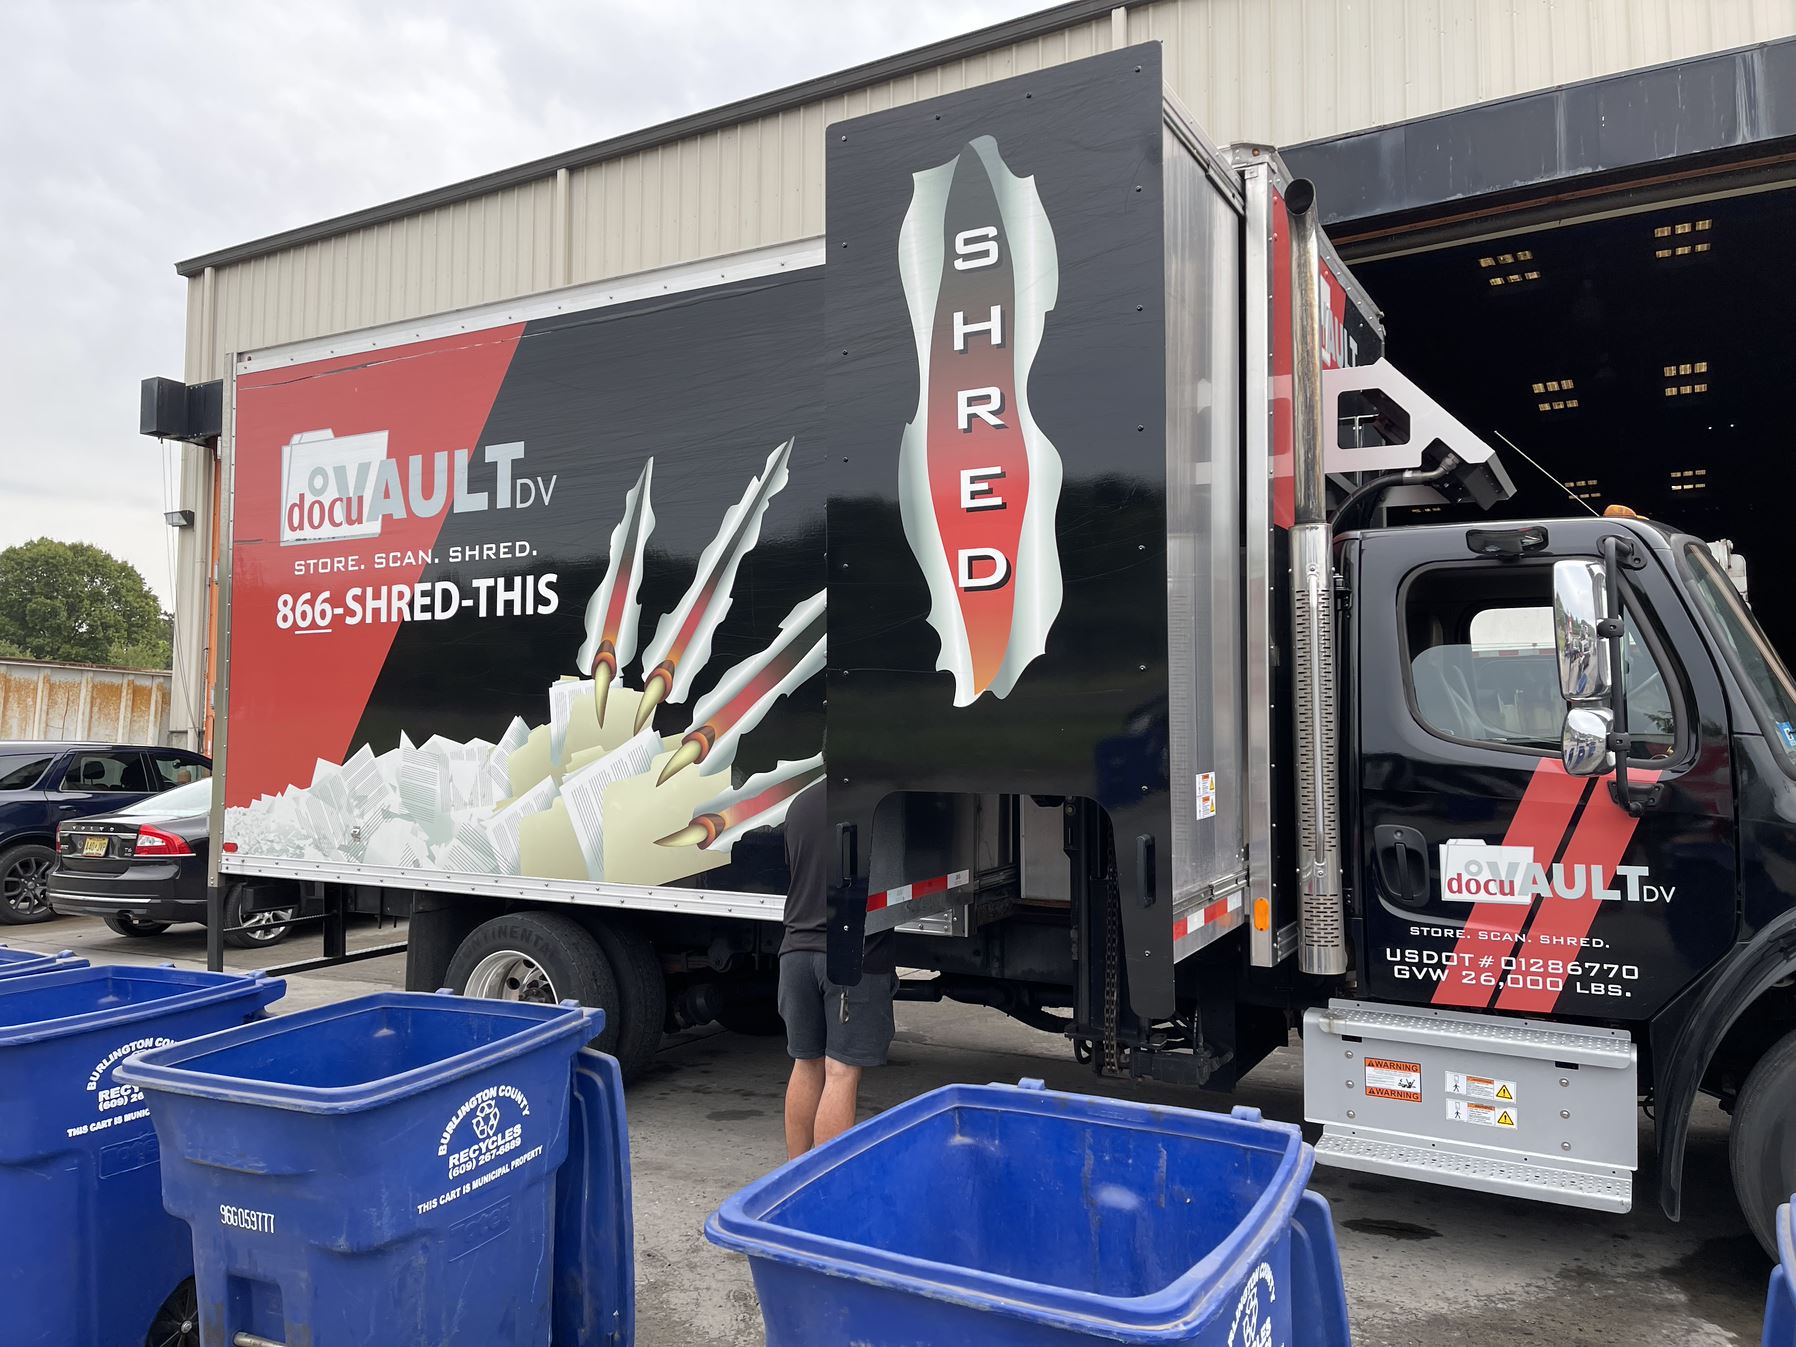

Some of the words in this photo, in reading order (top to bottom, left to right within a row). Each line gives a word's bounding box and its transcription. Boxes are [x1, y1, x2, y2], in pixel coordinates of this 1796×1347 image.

[953, 225, 1010, 590] SHRED
[294, 555, 366, 576] STORE.
[373, 548, 440, 569] SCAN.
[448, 540, 538, 563] SHRED.
[276, 573, 560, 631] 866-SHRED-THIS
[1409, 926, 1471, 939] STORE.
[1477, 930, 1532, 943] SCAN.
[1539, 934, 1611, 949] SHRED.
[1385, 947, 1475, 967] USDOT
[1478, 955, 1495, 968] #
[1500, 956, 1640, 980] 01286770
[1393, 965, 1450, 982] GVW
[1461, 970, 1563, 990] 26,000
[1575, 981, 1632, 997] LBS.
[86, 1037, 154, 1091] BURLINGTON
[1374, 1060, 1418, 1072] WARNING
[1375, 1088, 1419, 1100] WARNING
[66, 1124, 89, 1138] THIS
[89, 1118, 113, 1132] CART
[113, 1115, 123, 1126] IS
[437, 1086, 497, 1156] BURLINGTON
[498, 1085, 530, 1116] COUNTY
[448, 1123, 522, 1169] RECYCLES
[417, 1198, 438, 1215] THIS
[439, 1186, 462, 1205] CART
[462, 1182, 471, 1195] IS
[472, 1163, 511, 1191] MUNICIPAL
[511, 1144, 543, 1171] PROPERTY
[448, 1157, 477, 1180] (609)
